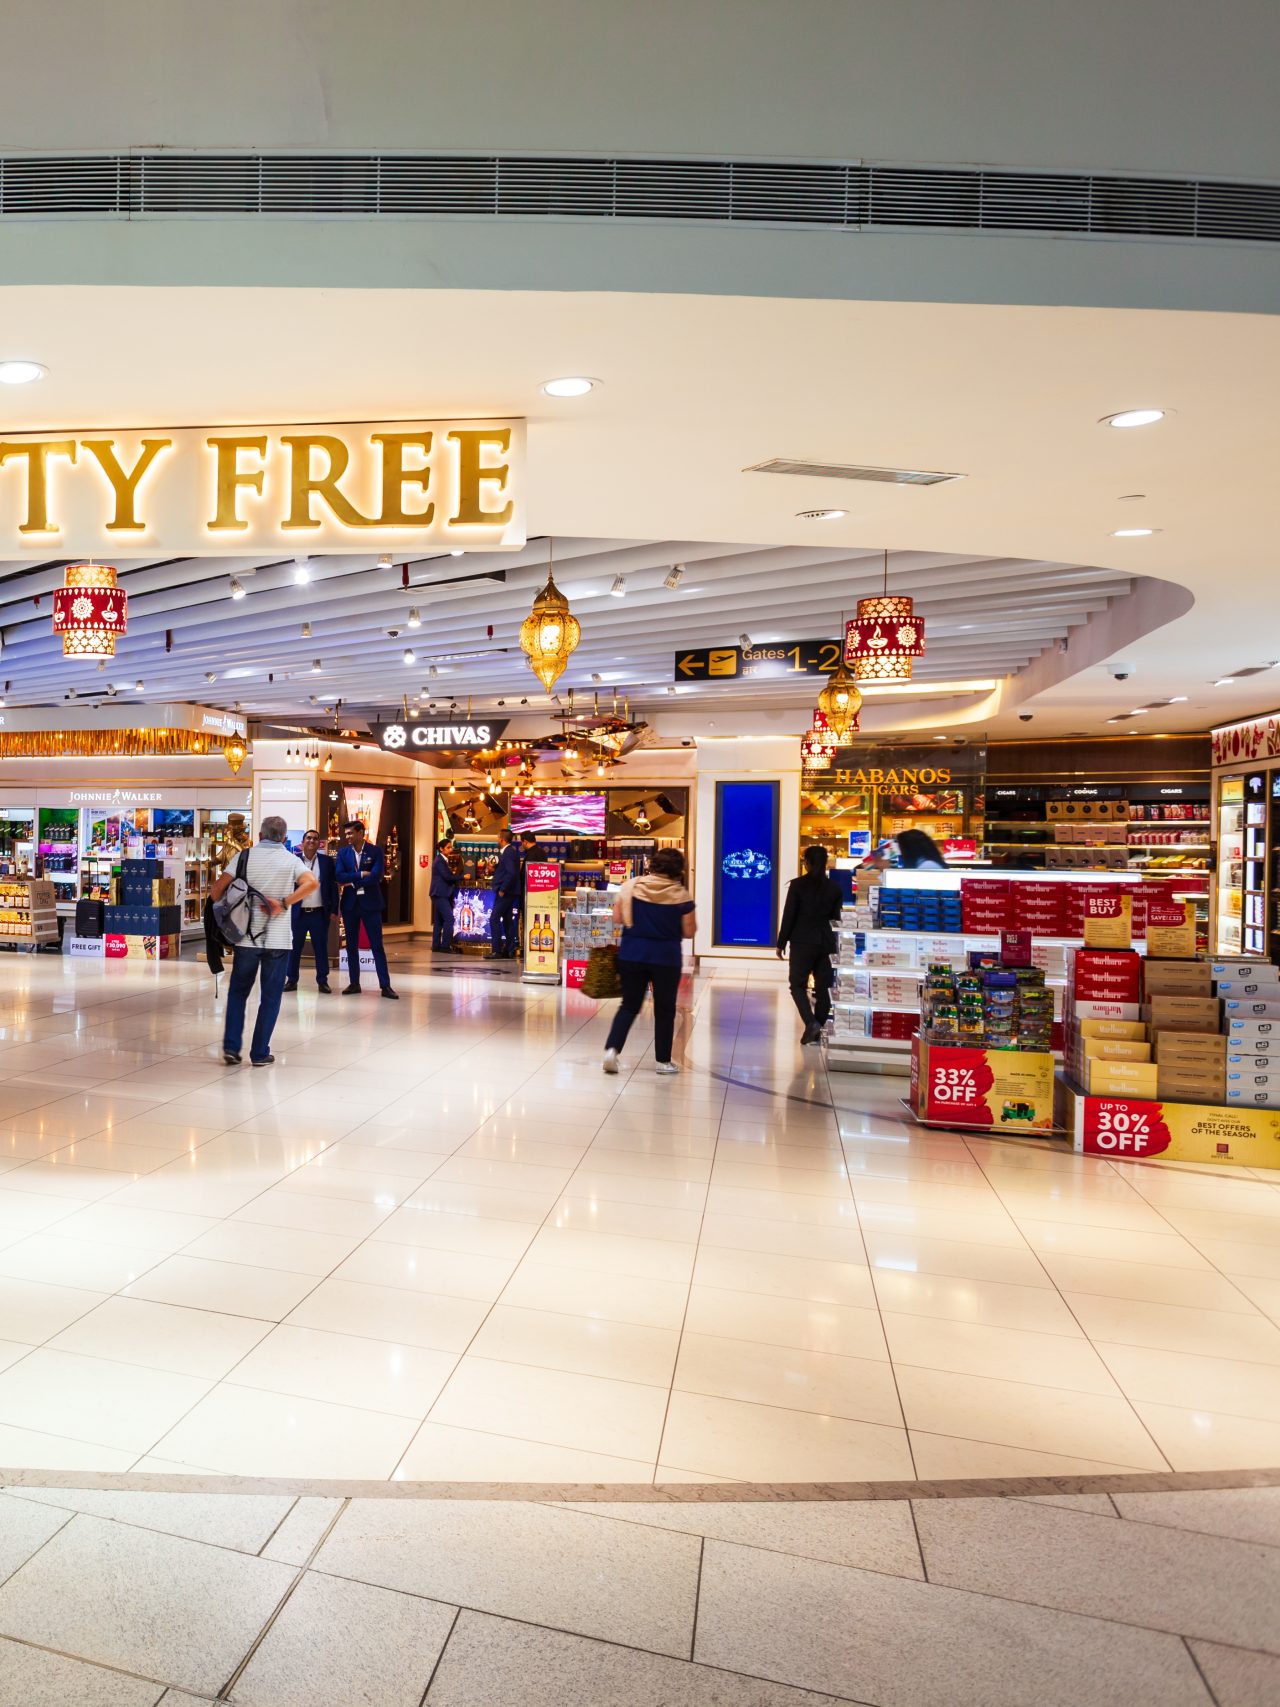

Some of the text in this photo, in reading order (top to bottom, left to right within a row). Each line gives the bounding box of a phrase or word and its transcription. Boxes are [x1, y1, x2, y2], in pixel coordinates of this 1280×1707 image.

[207, 427, 515, 532] FREE
[742, 648, 785, 660] Gates
[202, 713, 244, 730] JOHNNIE WALKER
[412, 726, 491, 745] CHIVAS
[834, 768, 952, 784] HABANOS
[861, 784, 920, 796] CIGARS
[69, 792, 162, 802] JOHNNIE WALKER
[529, 870, 556, 878] ₹3,990
[1089, 899, 1117, 907] BEST
[1093, 955, 1122, 965] Marlboro
[1092, 972, 1121, 982] Marlboro
[1092, 989, 1121, 999] Marlboro
[934, 1068, 976, 1086] 33%
[934, 1085, 977, 1102] OFF
[1097, 1112, 1150, 1133] 30%
[1218, 1123, 1251, 1132] OFFERS
[1222, 1130, 1256, 1138] SEASON
[1097, 1131, 1149, 1151] OFF
